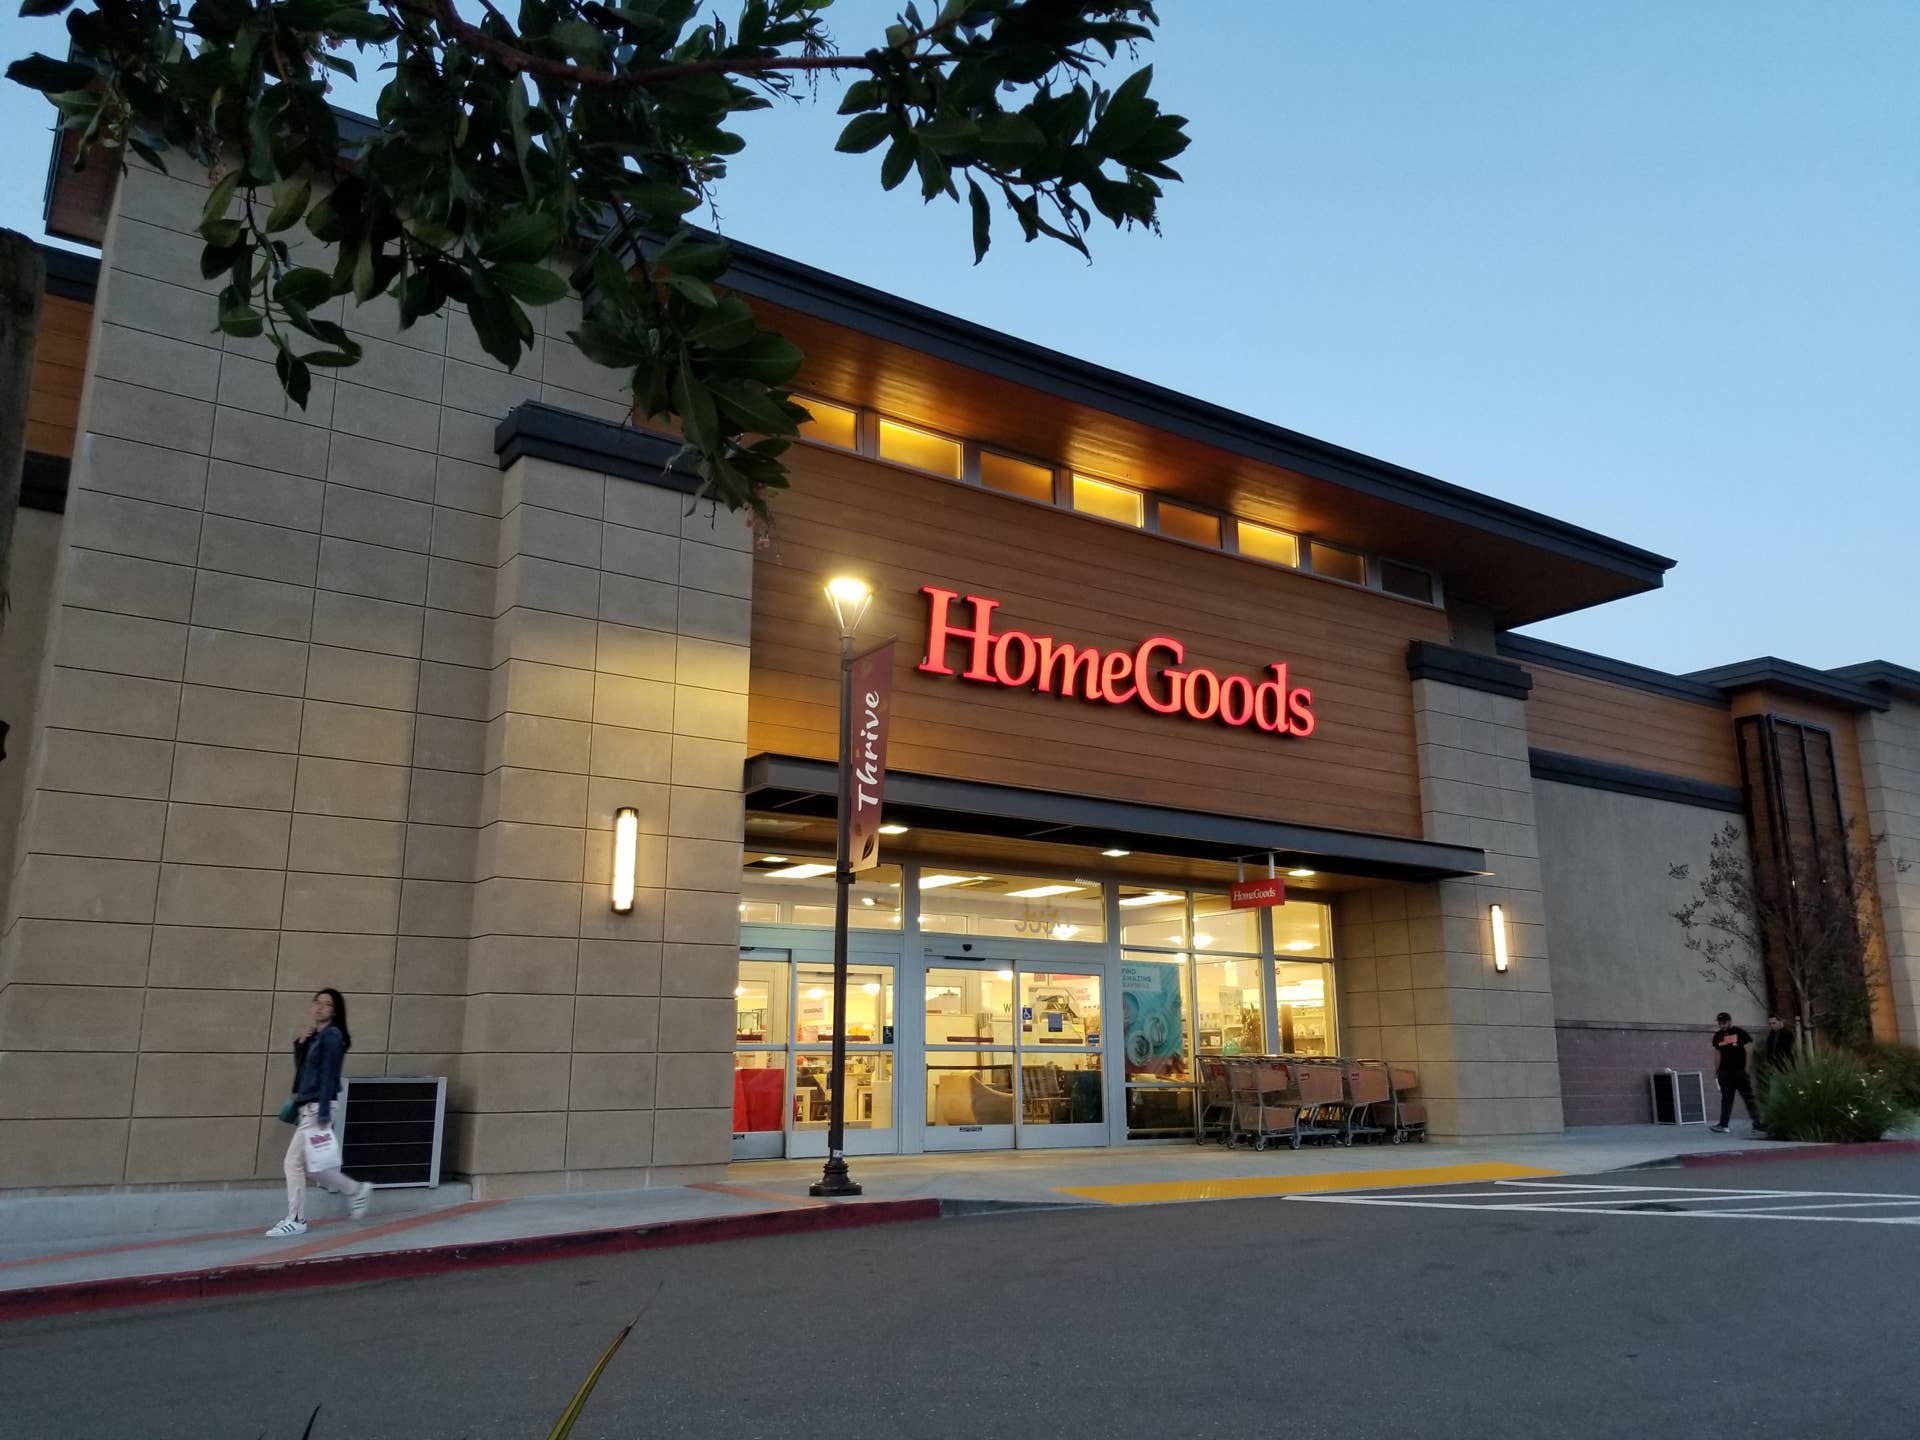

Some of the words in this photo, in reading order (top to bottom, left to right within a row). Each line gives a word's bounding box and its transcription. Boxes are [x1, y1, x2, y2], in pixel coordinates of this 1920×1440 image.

[918, 585, 1316, 738] HomeGoods
[856, 689, 880, 812] Thrive
[1233, 887, 1276, 901] HomeGoods
